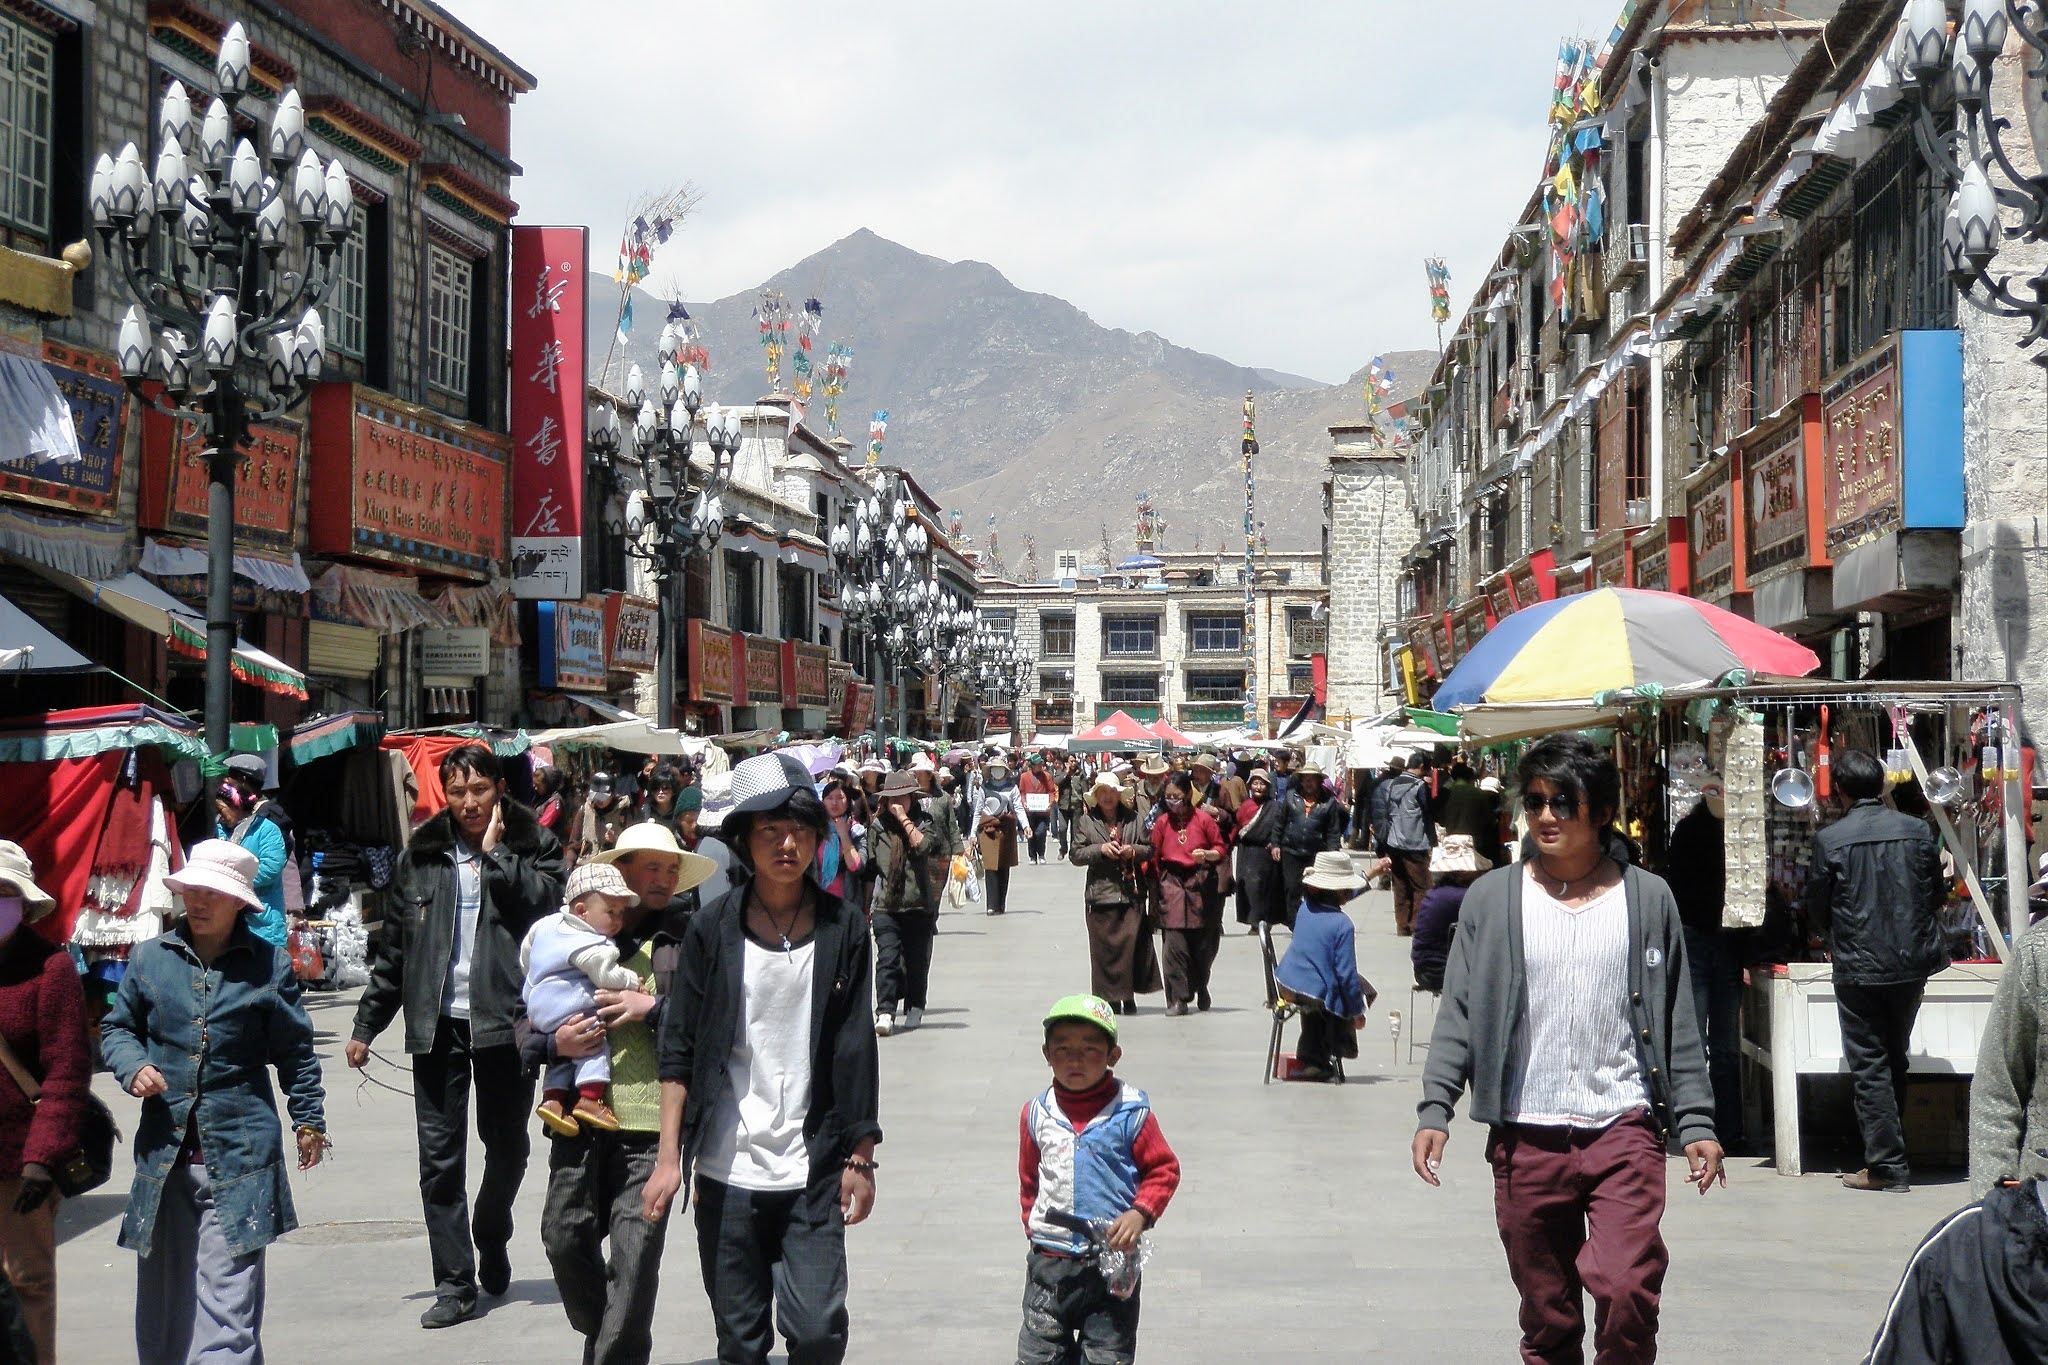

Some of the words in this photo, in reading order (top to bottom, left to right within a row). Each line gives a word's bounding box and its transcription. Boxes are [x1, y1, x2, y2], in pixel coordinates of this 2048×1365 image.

[366, 498, 389, 527] Xing
[393, 506, 414, 528] Hua
[418, 512, 443, 537] Book
[448, 520, 472, 546] Shop
